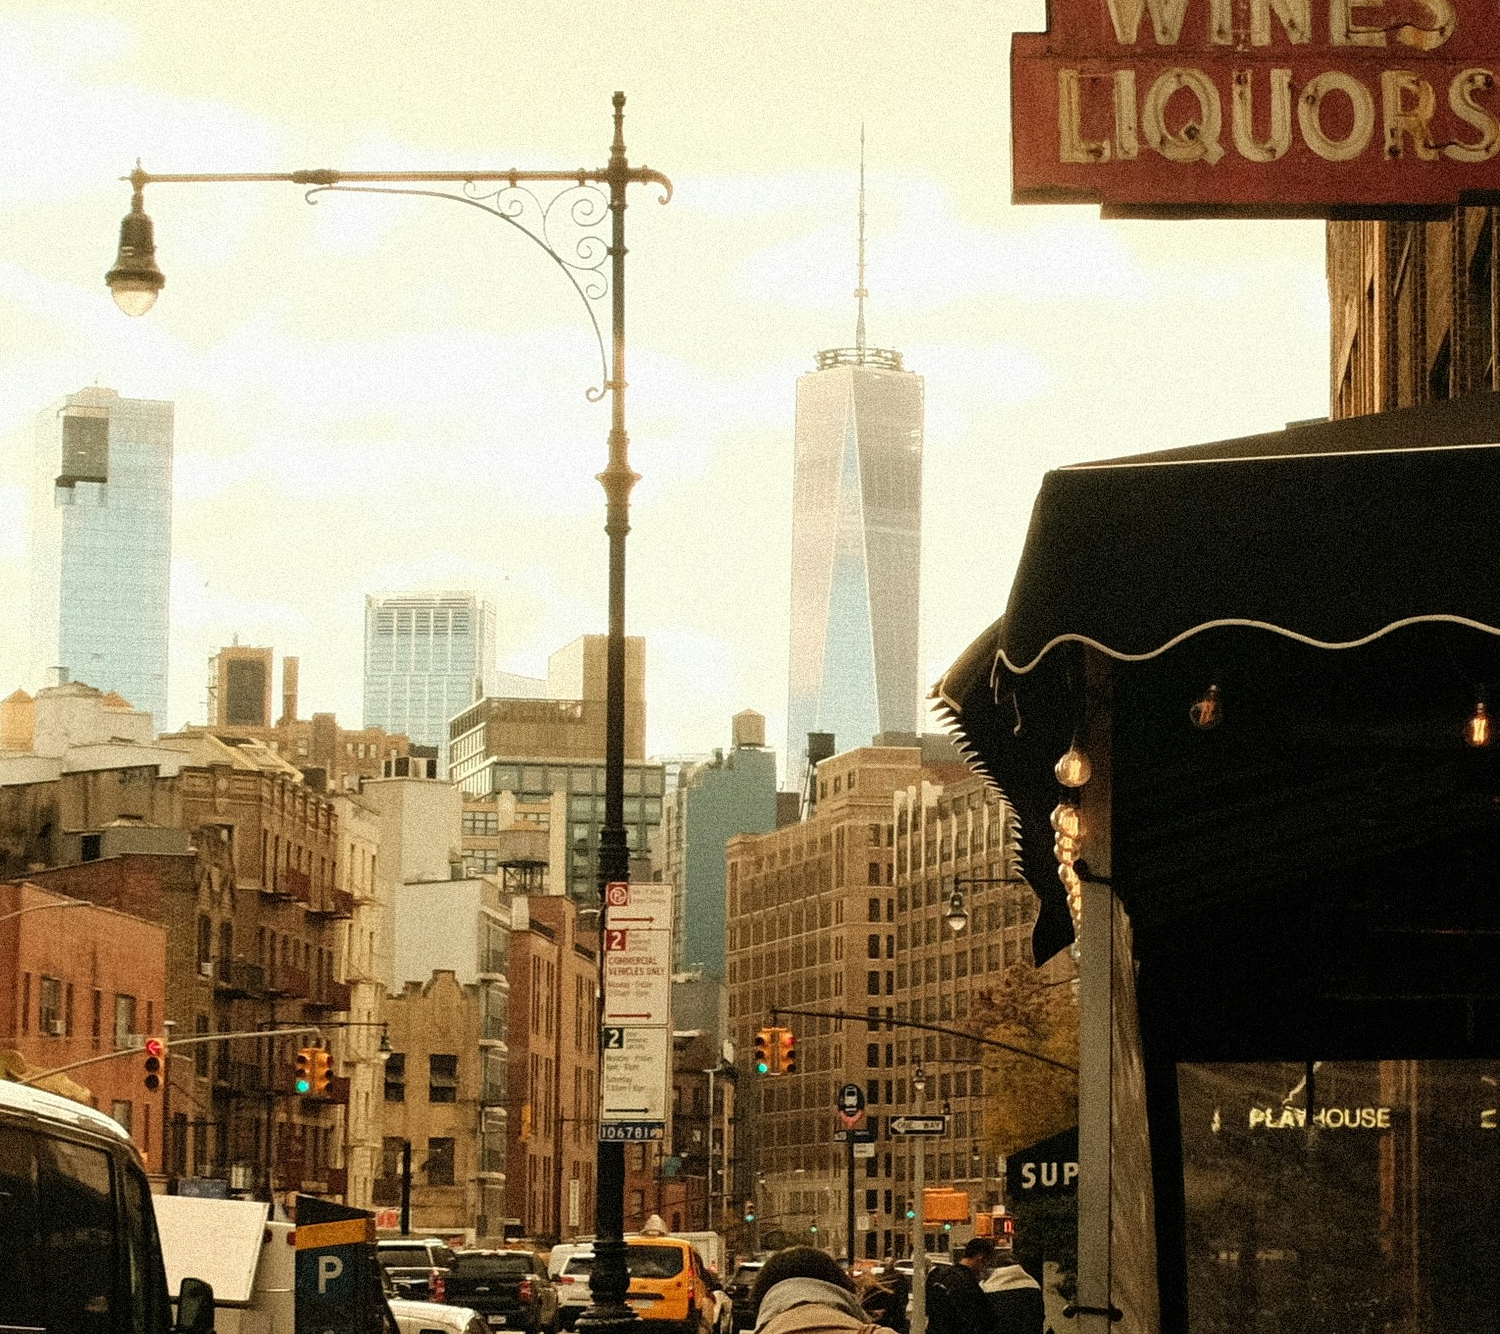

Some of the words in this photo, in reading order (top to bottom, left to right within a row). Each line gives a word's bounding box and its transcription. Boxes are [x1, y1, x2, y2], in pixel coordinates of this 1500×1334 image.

[611, 932, 621, 950] 2
[608, 1029, 620, 1048] 2
[1020, 1161, 1079, 1190] SUP
[317, 1255, 344, 1295] P
